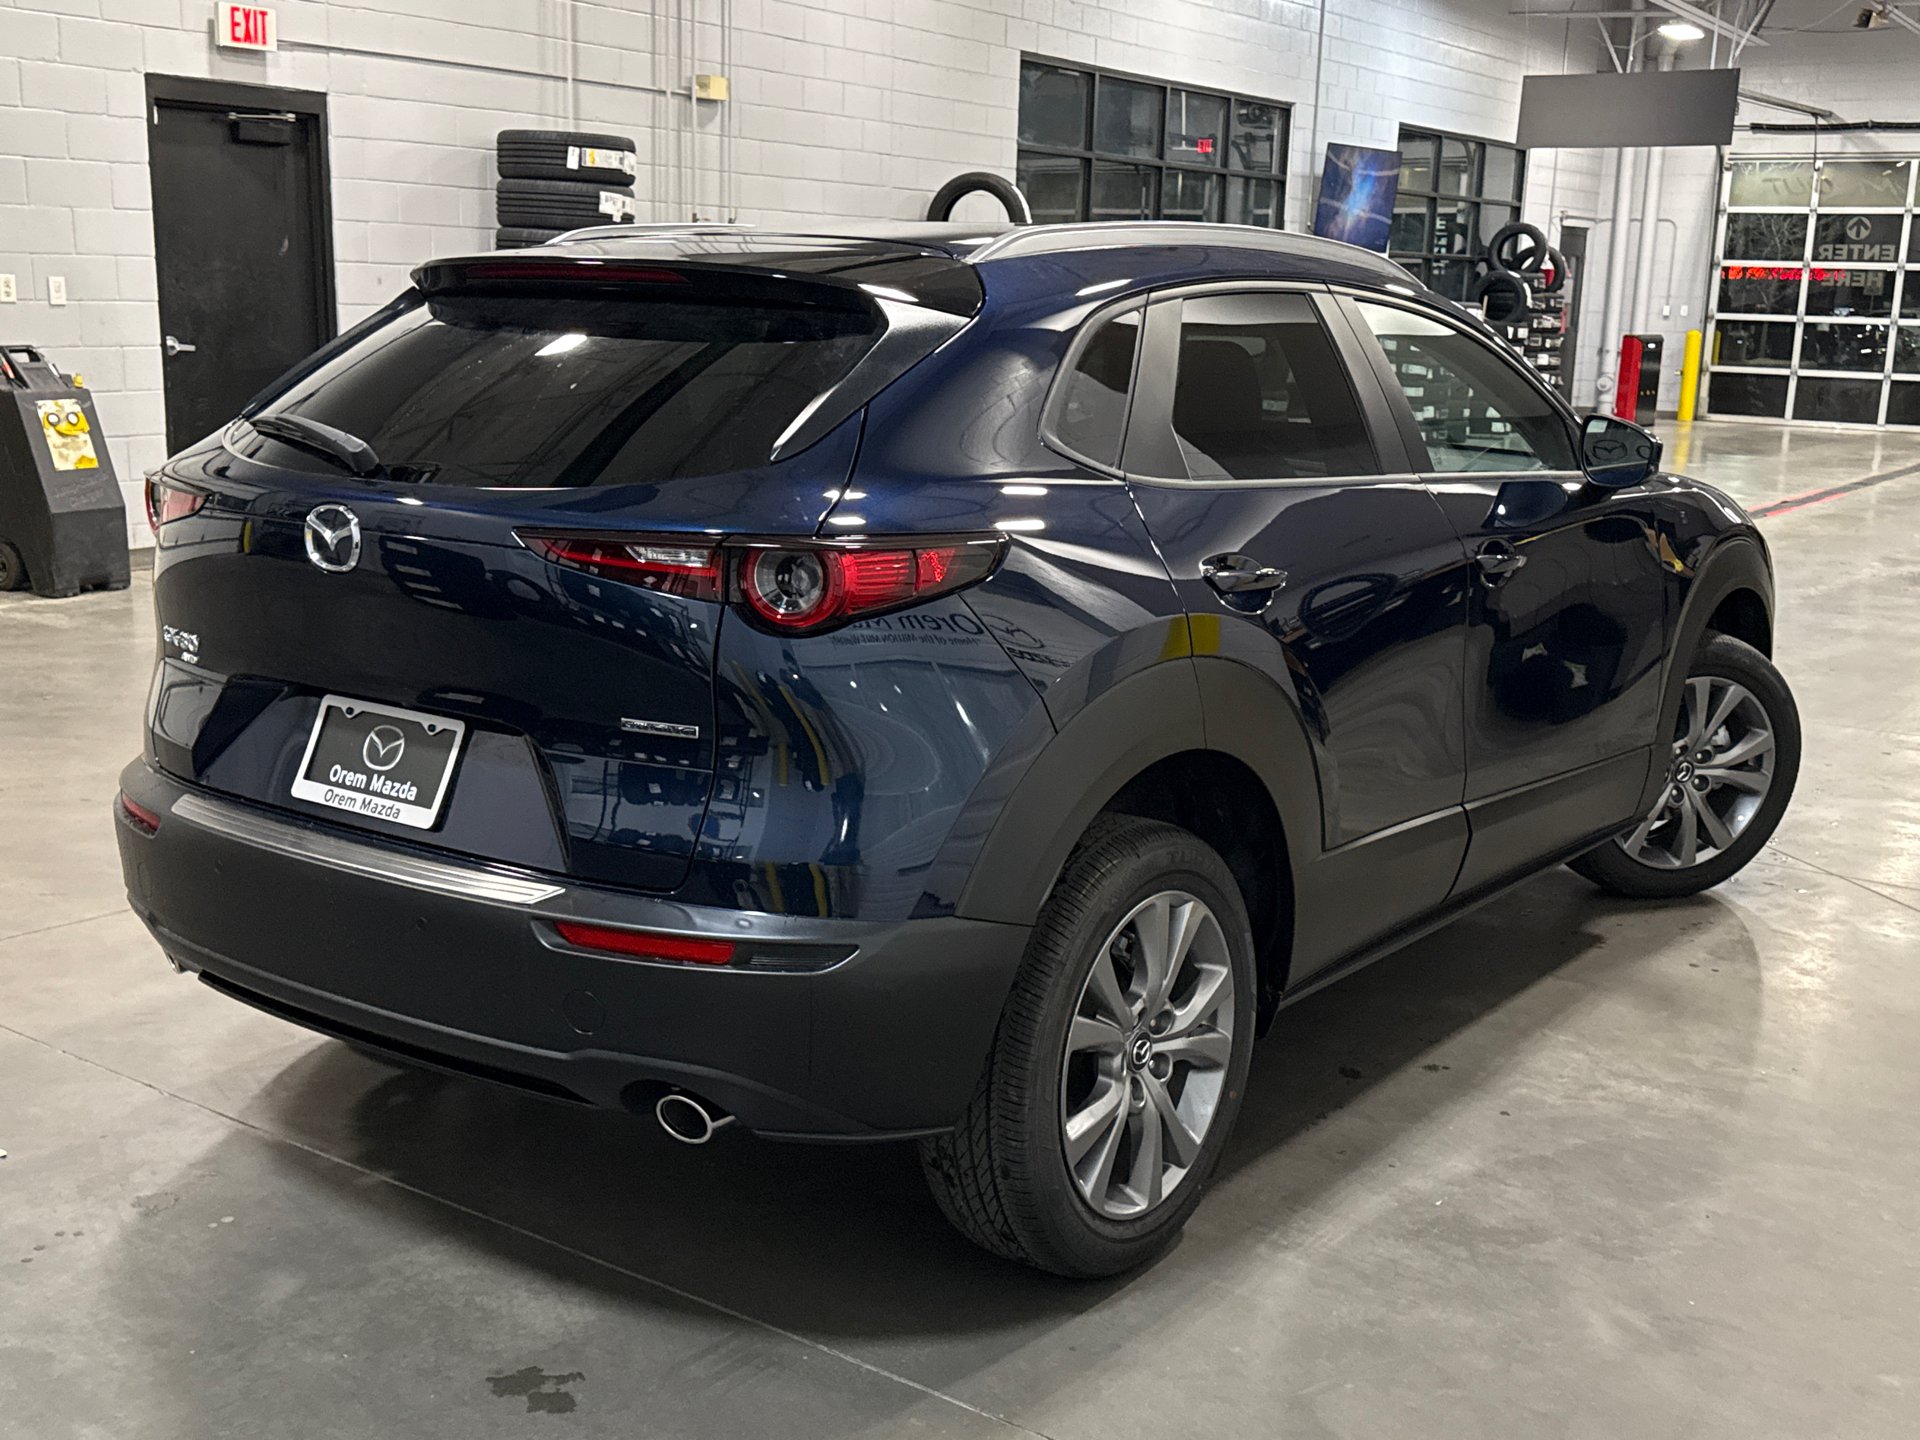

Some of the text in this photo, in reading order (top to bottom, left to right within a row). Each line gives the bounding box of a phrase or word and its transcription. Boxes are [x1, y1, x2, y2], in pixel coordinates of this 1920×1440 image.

[230, 6, 268, 45] EXIT
[328, 764, 418, 801] Orem Mazda
[324, 789, 401, 819] Orem Mazda
